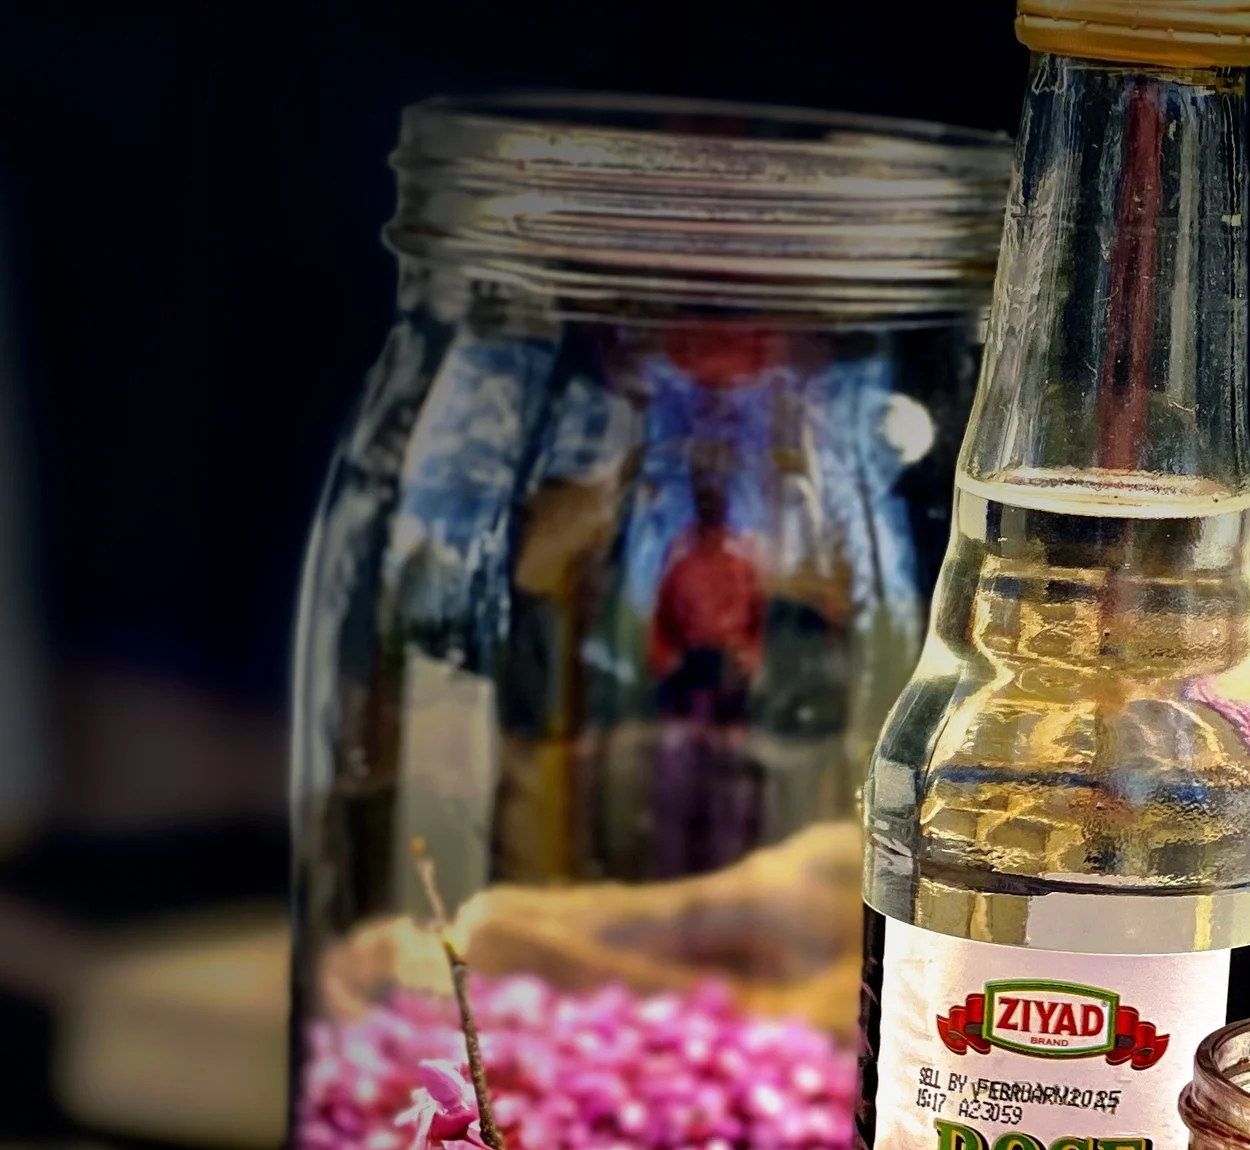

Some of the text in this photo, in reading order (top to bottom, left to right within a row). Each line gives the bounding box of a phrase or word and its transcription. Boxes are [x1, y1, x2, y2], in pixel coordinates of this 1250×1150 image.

[996, 996, 1105, 1037] ZIYAD
[1030, 1036, 1070, 1048] BRAND
[919, 1066, 941, 1089] SELL
[948, 1073, 968, 1093] BY
